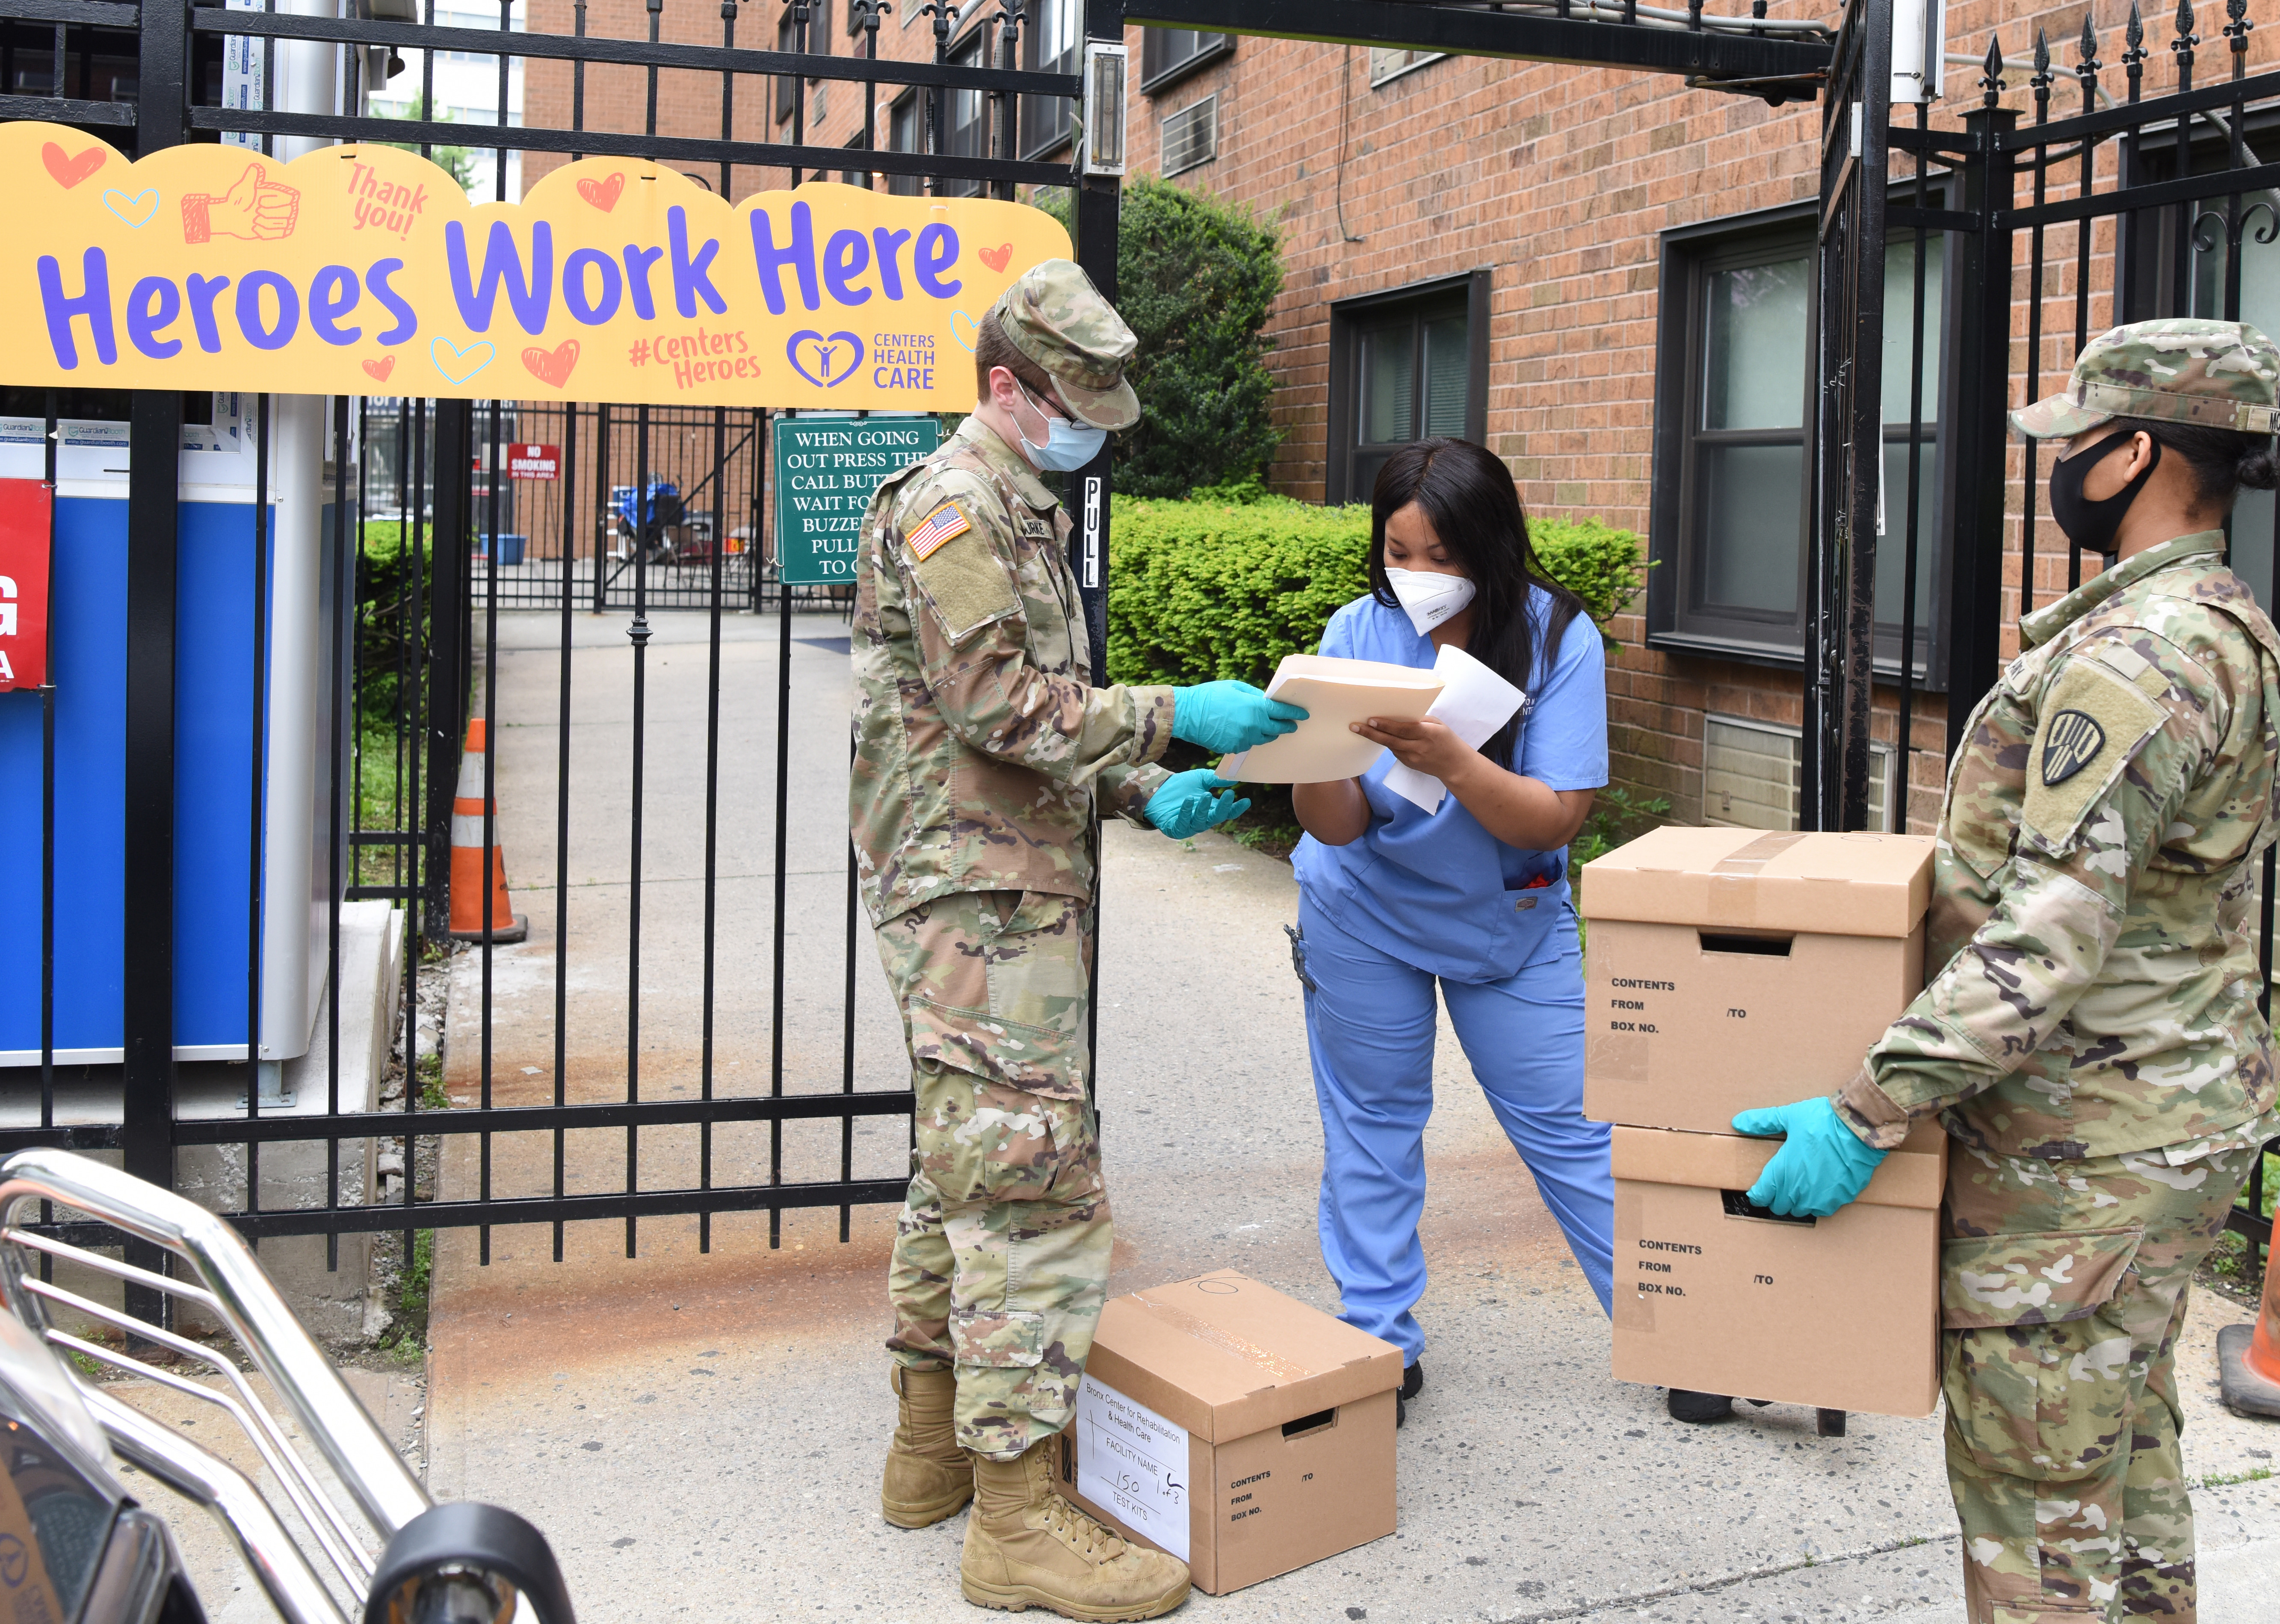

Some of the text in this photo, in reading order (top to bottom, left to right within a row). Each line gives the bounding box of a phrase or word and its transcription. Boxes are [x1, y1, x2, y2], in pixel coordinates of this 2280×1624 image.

[348, 162, 428, 214] Thank
[353, 197, 414, 241] you!
[37, 201, 962, 370] Heroes Work Here
[628, 327, 748, 367] #Centers
[874, 333, 934, 348] CENTERS
[874, 349, 934, 365] HEALTH
[674, 356, 761, 390] Heroes
[873, 366, 934, 389] CARE
[795, 431, 920, 447] WHEN GOING
[527, 446, 541, 458] NO
[512, 458, 556, 472] SMOKING
[787, 454, 828, 469] OUT
[833, 453, 886, 467] PRESS
[792, 475, 839, 490] CALL
[793, 496, 843, 511] WAIT
[1086, 479, 1098, 586] PULL
[811, 538, 858, 553] PULL
[819, 560, 846, 574] TO
[1612, 978, 1675, 991] CONTENTS
[1611, 999, 1644, 1010] FROM
[1611, 1021, 1659, 1033] BOX NO.
[1639, 1240, 1702, 1255] CONTENTS
[1638, 1261, 1671, 1273] FROM
[1638, 1282, 1686, 1296] BOX NO.
[1087, 1382, 1180, 1444] Bronx Center for Rehabilitation
[1108, 1411, 1151, 1443] & Health Care
[1106, 1438, 1158, 1476] FACILITY NAME
[1117, 1470, 1139, 1492] 150
[1231, 1470, 1271, 1488] CONTENTS
[1113, 1491, 1147, 1521] TEST KITS
[1231, 1493, 1252, 1505] FROM
[1231, 1507, 1262, 1521] BOX NO.
